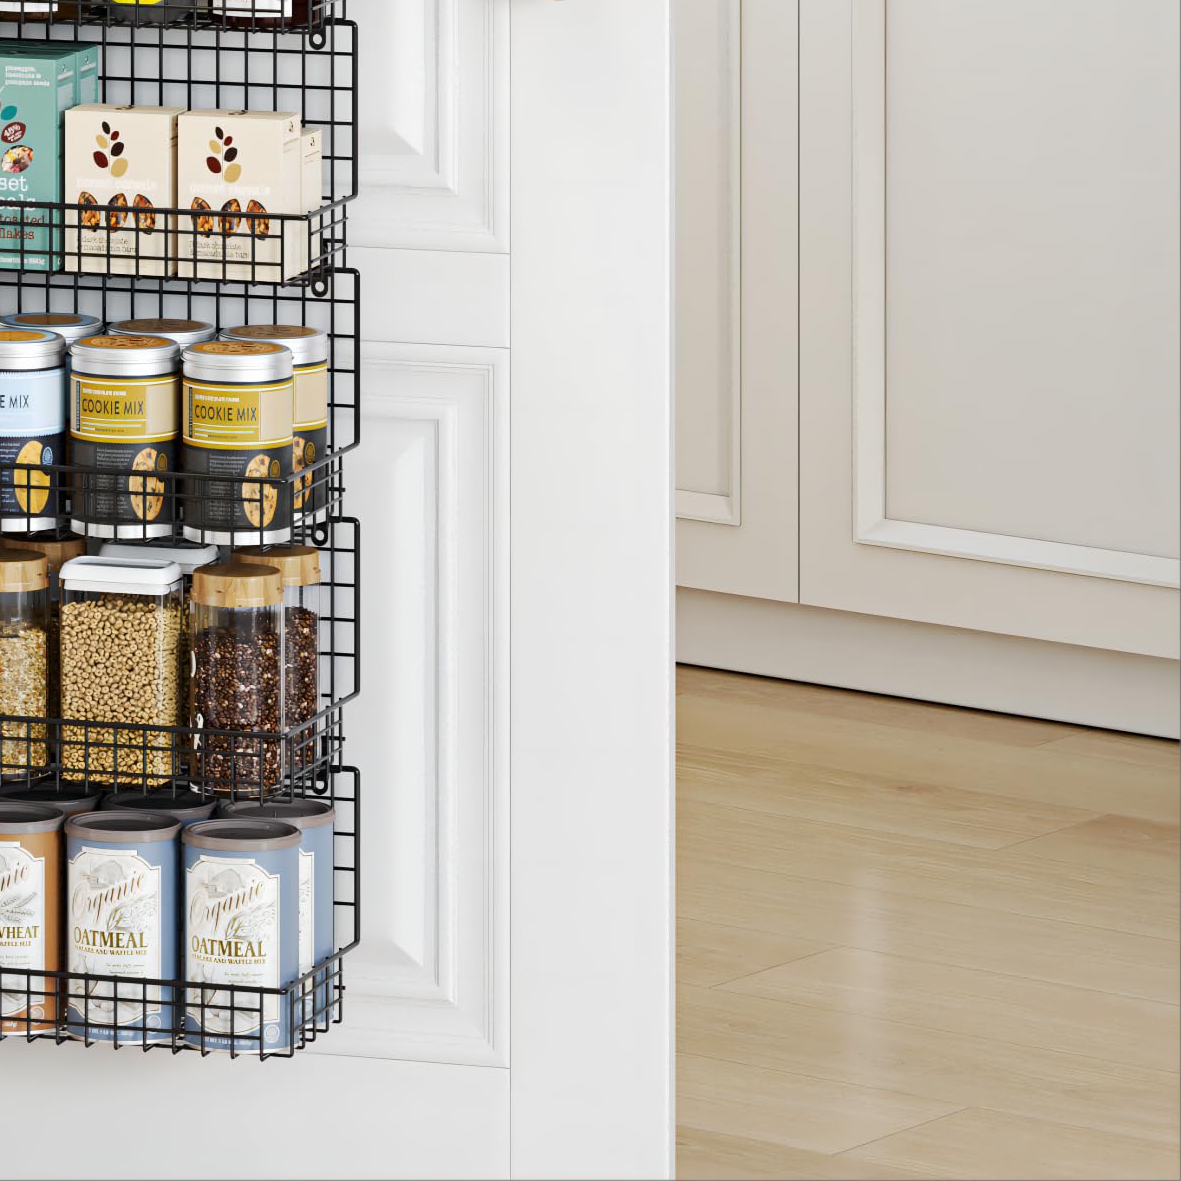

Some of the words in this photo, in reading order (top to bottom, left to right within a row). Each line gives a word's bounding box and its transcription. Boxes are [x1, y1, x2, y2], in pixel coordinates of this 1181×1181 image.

[0, 213, 45, 224] toated
[8, 394, 30, 409] MIX
[81, 398, 120, 415] COOKIE
[123, 400, 144, 415] MIX
[194, 404, 233, 421] COOKIE
[236, 407, 257, 421] MIX
[71, 870, 146, 924] Organic
[189, 879, 264, 933] Organic
[73, 926, 148, 949] OATMEAL
[191, 934, 267, 958] OATMEAL
